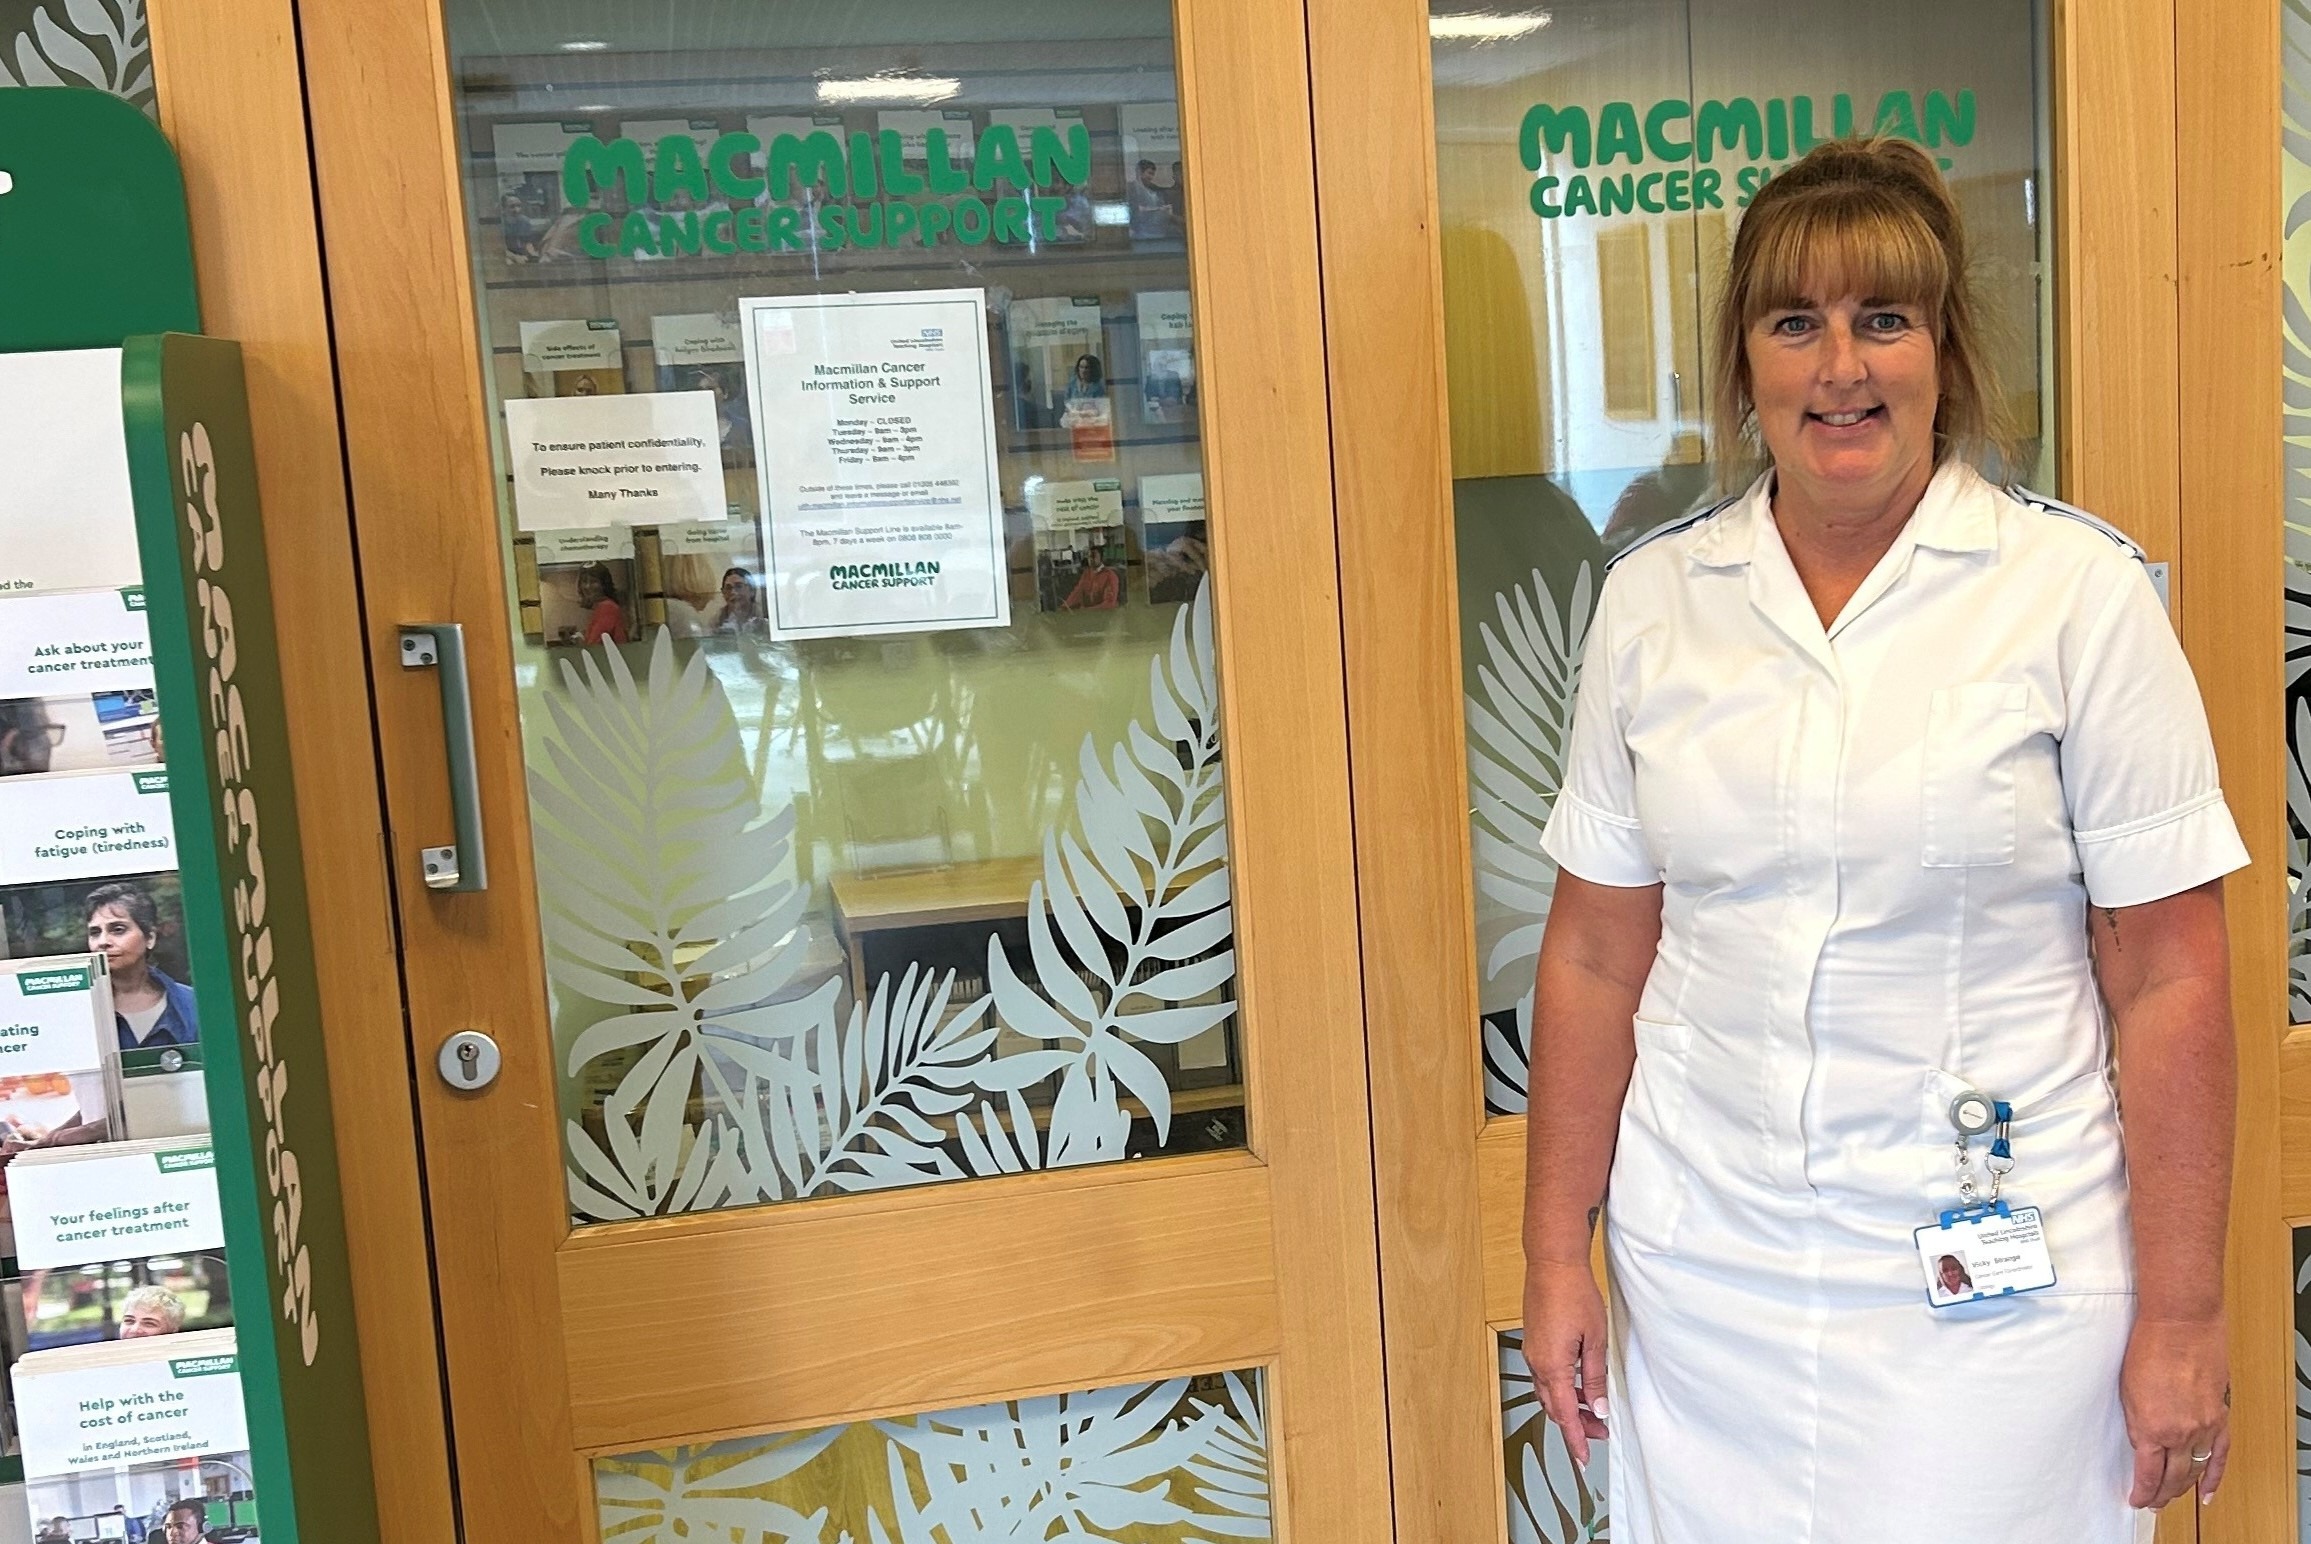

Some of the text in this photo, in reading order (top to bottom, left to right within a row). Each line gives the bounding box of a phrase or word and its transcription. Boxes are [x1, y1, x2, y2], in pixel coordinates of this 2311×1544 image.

[1519, 87, 1977, 171] MACMILLAN
[563, 124, 1091, 207] MACMILLAN
[1529, 169, 1724, 218] CANCER
[579, 197, 1067, 259] CANCER SUPPORT
[814, 362, 926, 375] Macmillan Cancer
[801, 376, 941, 391] Information & Support
[849, 393, 896, 404] Service
[876, 416, 911, 425] CLOSED
[533, 442, 547, 452] To
[549, 442, 586, 452] ensure
[588, 440, 625, 452] patient
[540, 462, 702, 476] Please knock prior to entering.
[588, 488, 658, 500] Many Thanks
[799, 529, 814, 537] The
[816, 528, 853, 536] Macmillan
[855, 527, 884, 535] Support
[885, 526, 902, 534] Line
[911, 524, 943, 532] available
[840, 537, 857, 545] days
[830, 560, 940, 580] MACMILLAN
[14, 579, 34, 590] the
[832, 576, 935, 590] CANCER SUPPORT
[34, 641, 144, 657] Ask about your
[28, 656, 153, 673] cancer treatment
[55, 822, 146, 840] Coping with
[34, 836, 169, 858] fatigue (tiredness)
[192, 422, 318, 1366] MACMILLAN
[50, 1201, 190, 1226] Your feelings after
[2012, 1213, 2035, 1224] NHS
[56, 1218, 189, 1242] cancer treatment
[176, 1357, 233, 1370] MACMILLAN
[203, 1363, 231, 1372] SUPPORT
[79, 1390, 184, 1411] Help with the
[80, 1407, 189, 1428] cost of cancer
[82, 1431, 192, 1451] in England, Scotland,
[68, 1440, 209, 1465] Wales and Northern Ireland
